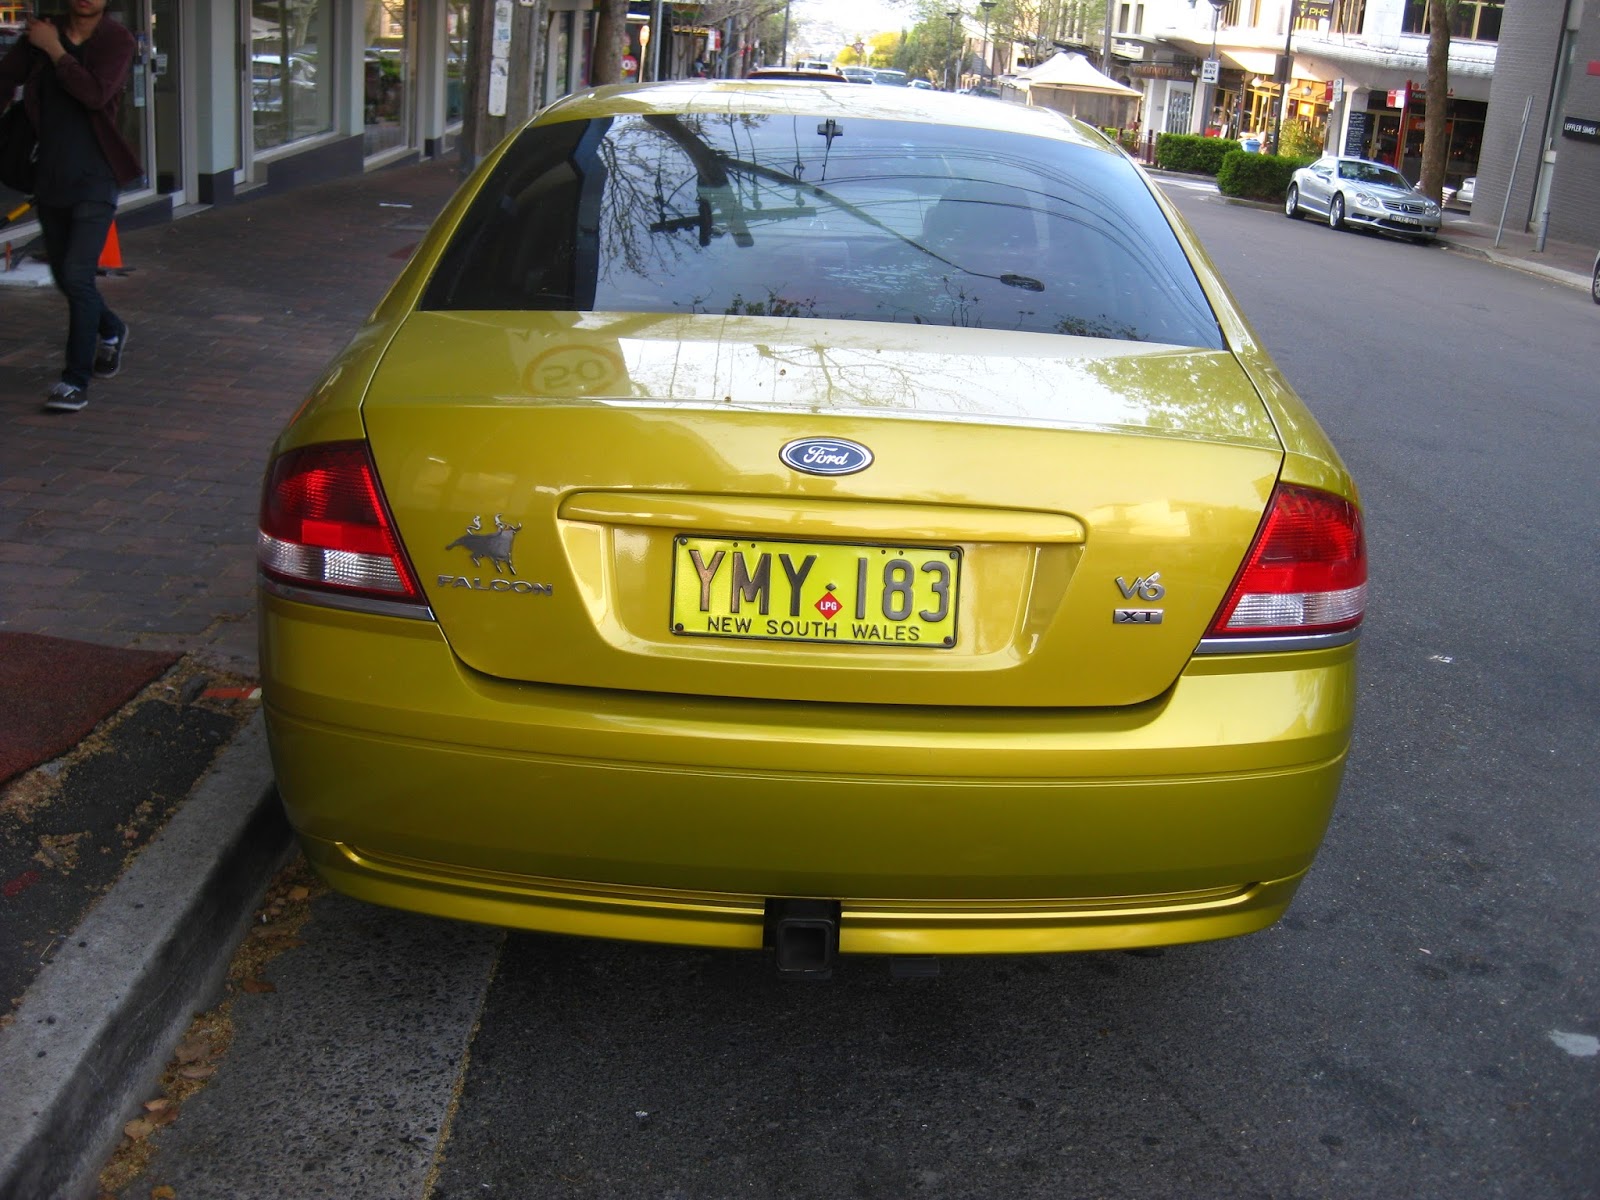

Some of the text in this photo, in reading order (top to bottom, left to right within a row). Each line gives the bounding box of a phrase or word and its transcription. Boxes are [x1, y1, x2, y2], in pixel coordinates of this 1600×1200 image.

[1309, 7, 1329, 17] PHC
[803, 445, 849, 465] Ford
[437, 574, 553, 597] FALCON
[688, 549, 951, 623] YMY 183
[1114, 571, 1166, 602] V6
[820, 601, 837, 611] LPG
[1120, 611, 1158, 622] XT
[707, 615, 920, 641] NEW SOUTH WALES
